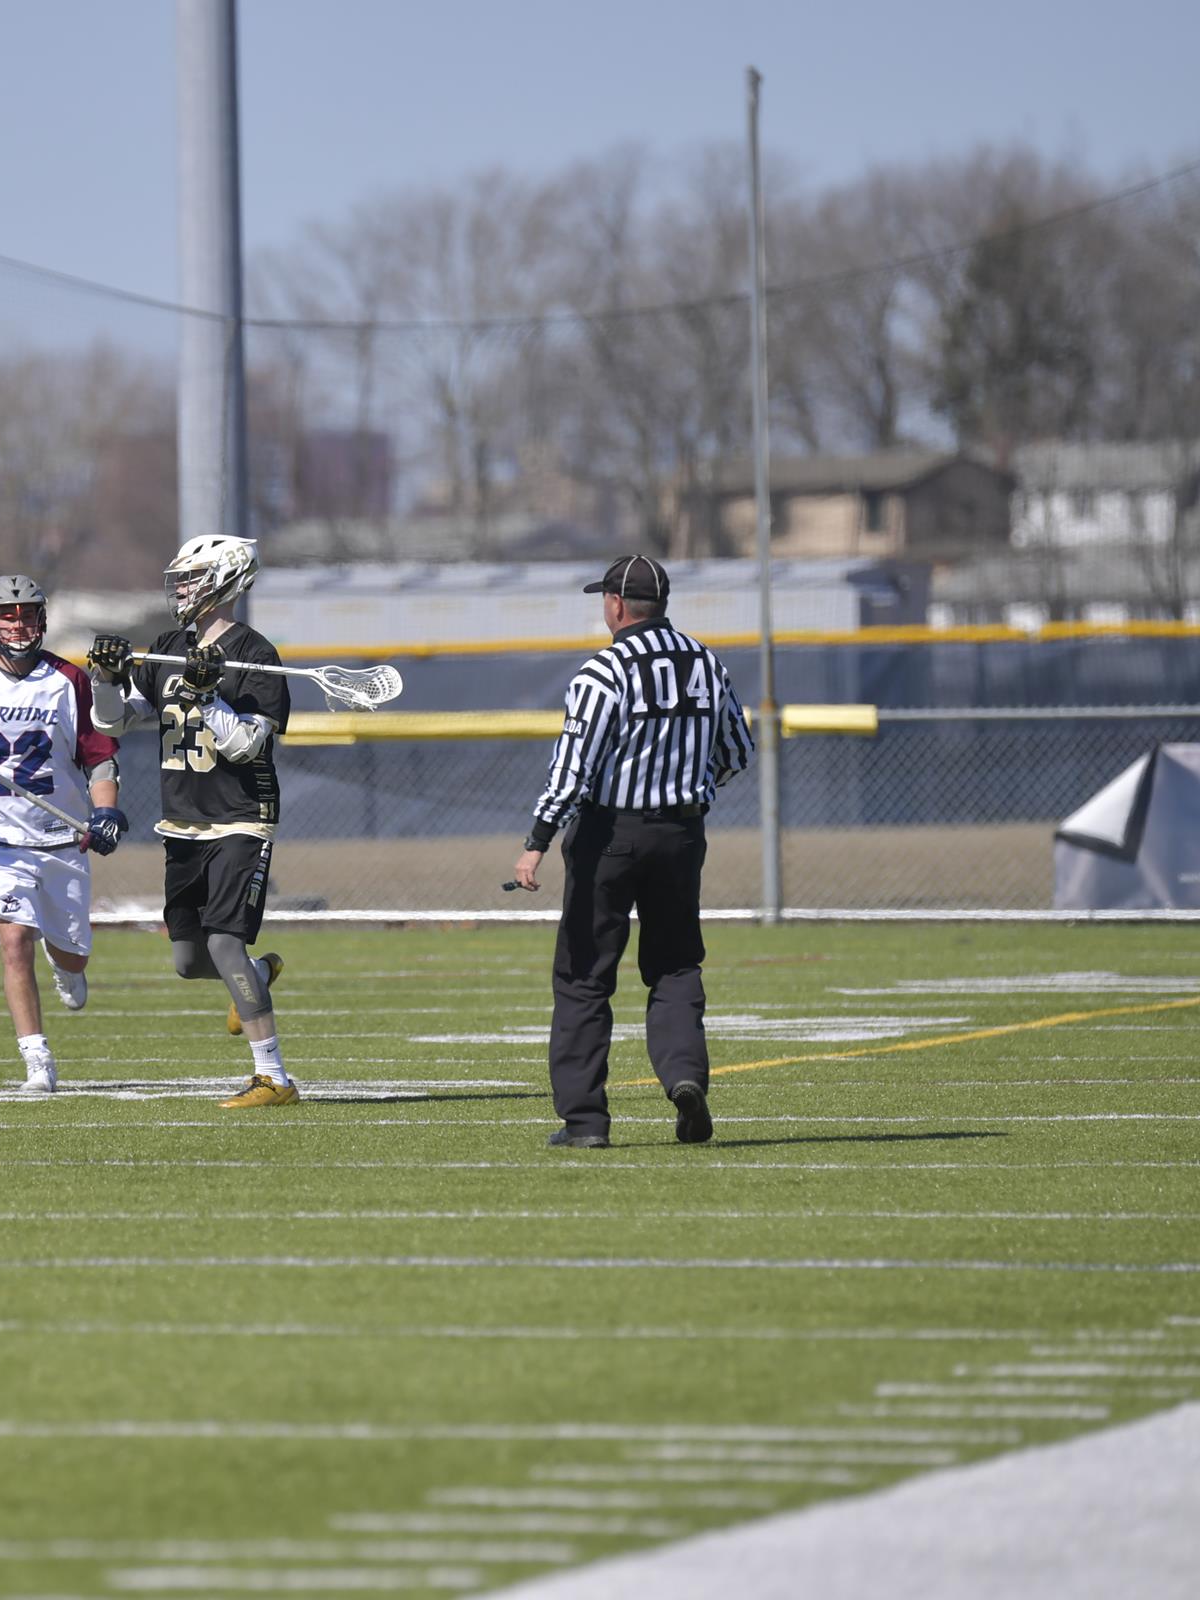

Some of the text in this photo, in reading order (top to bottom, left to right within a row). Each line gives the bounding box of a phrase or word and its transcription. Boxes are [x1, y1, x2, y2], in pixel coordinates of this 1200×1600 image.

[225, 546, 250, 568] 23
[628, 656, 712, 714] 104
[160, 704, 218, 773] 23
